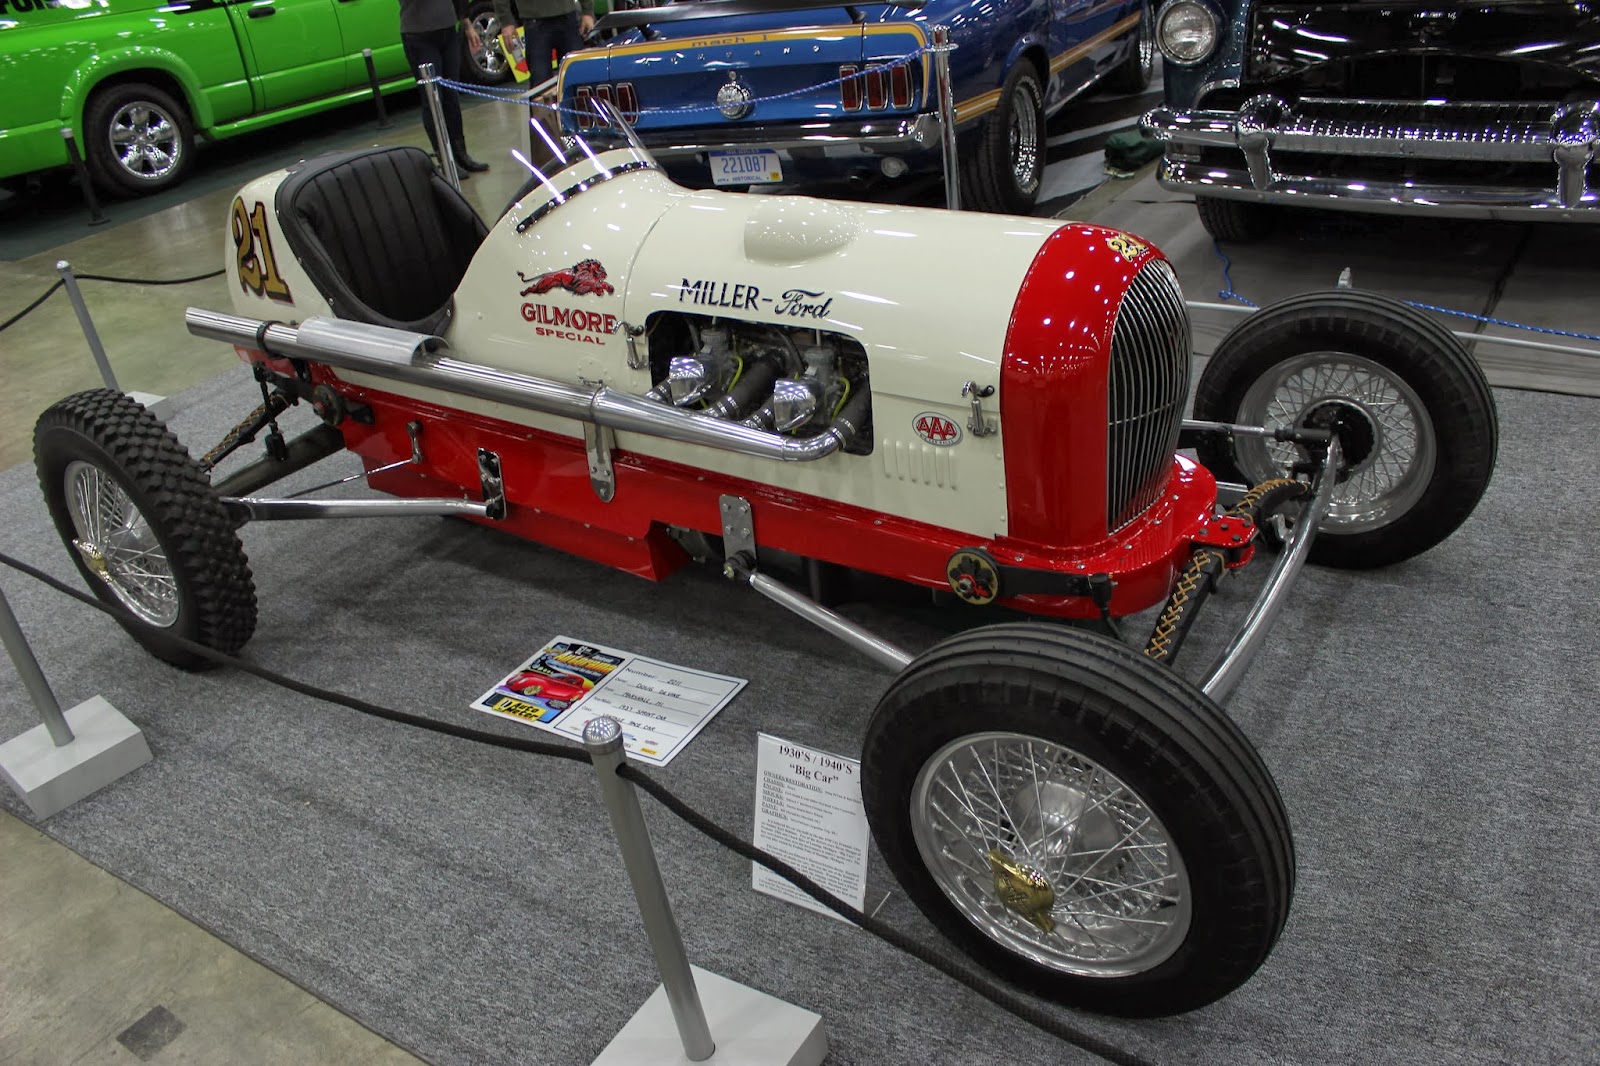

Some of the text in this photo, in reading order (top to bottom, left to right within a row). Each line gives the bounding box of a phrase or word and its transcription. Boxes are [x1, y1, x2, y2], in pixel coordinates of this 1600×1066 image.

[692, 37, 746, 48] mach
[721, 155, 767, 173] 221087
[231, 195, 295, 307] 21
[1106, 233, 1149, 262] 21
[520, 302, 618, 335] GILMORE
[535, 327, 606, 345] SPECIAL
[916, 416, 957, 440] AAA
[513, 702, 540, 713] Auto
[779, 744, 811, 763] 1930’S
[820, 756, 853, 775] 1940’S
